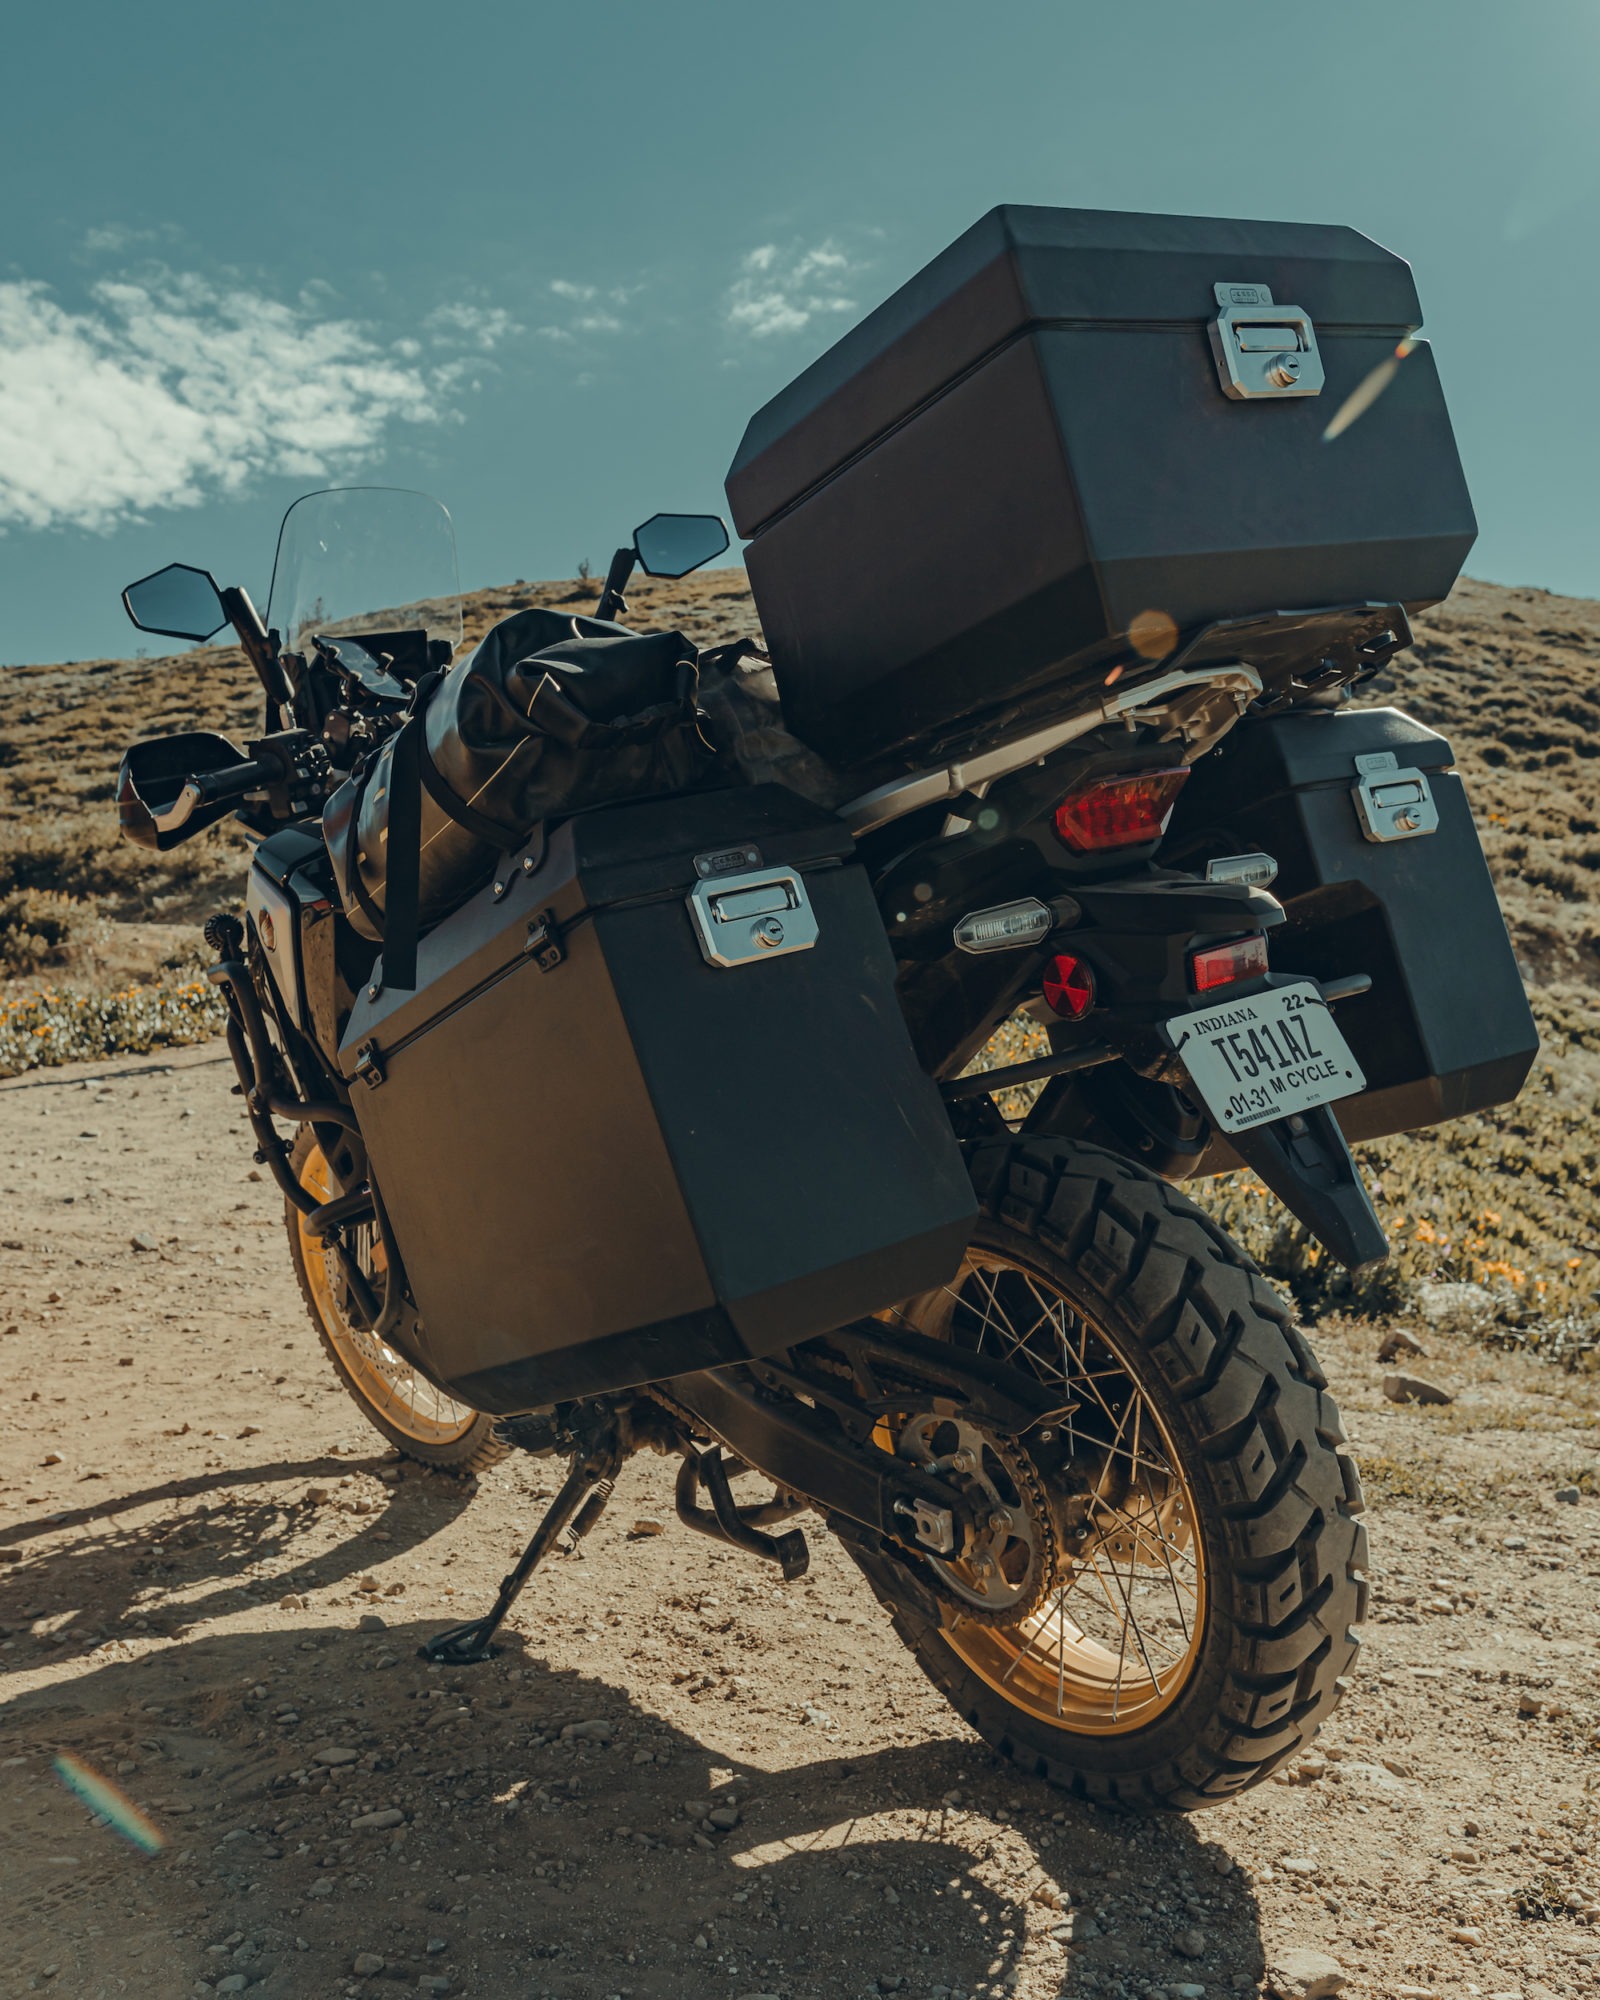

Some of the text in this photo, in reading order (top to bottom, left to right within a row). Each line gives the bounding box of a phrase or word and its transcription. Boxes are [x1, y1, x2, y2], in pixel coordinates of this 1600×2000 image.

[1193, 1007, 1258, 1036] INDIANA
[1282, 993, 1305, 1012] 22
[1211, 1014, 1323, 1083] T541AZ
[1229, 1059, 1339, 1114] 01-31 M CYCLE
